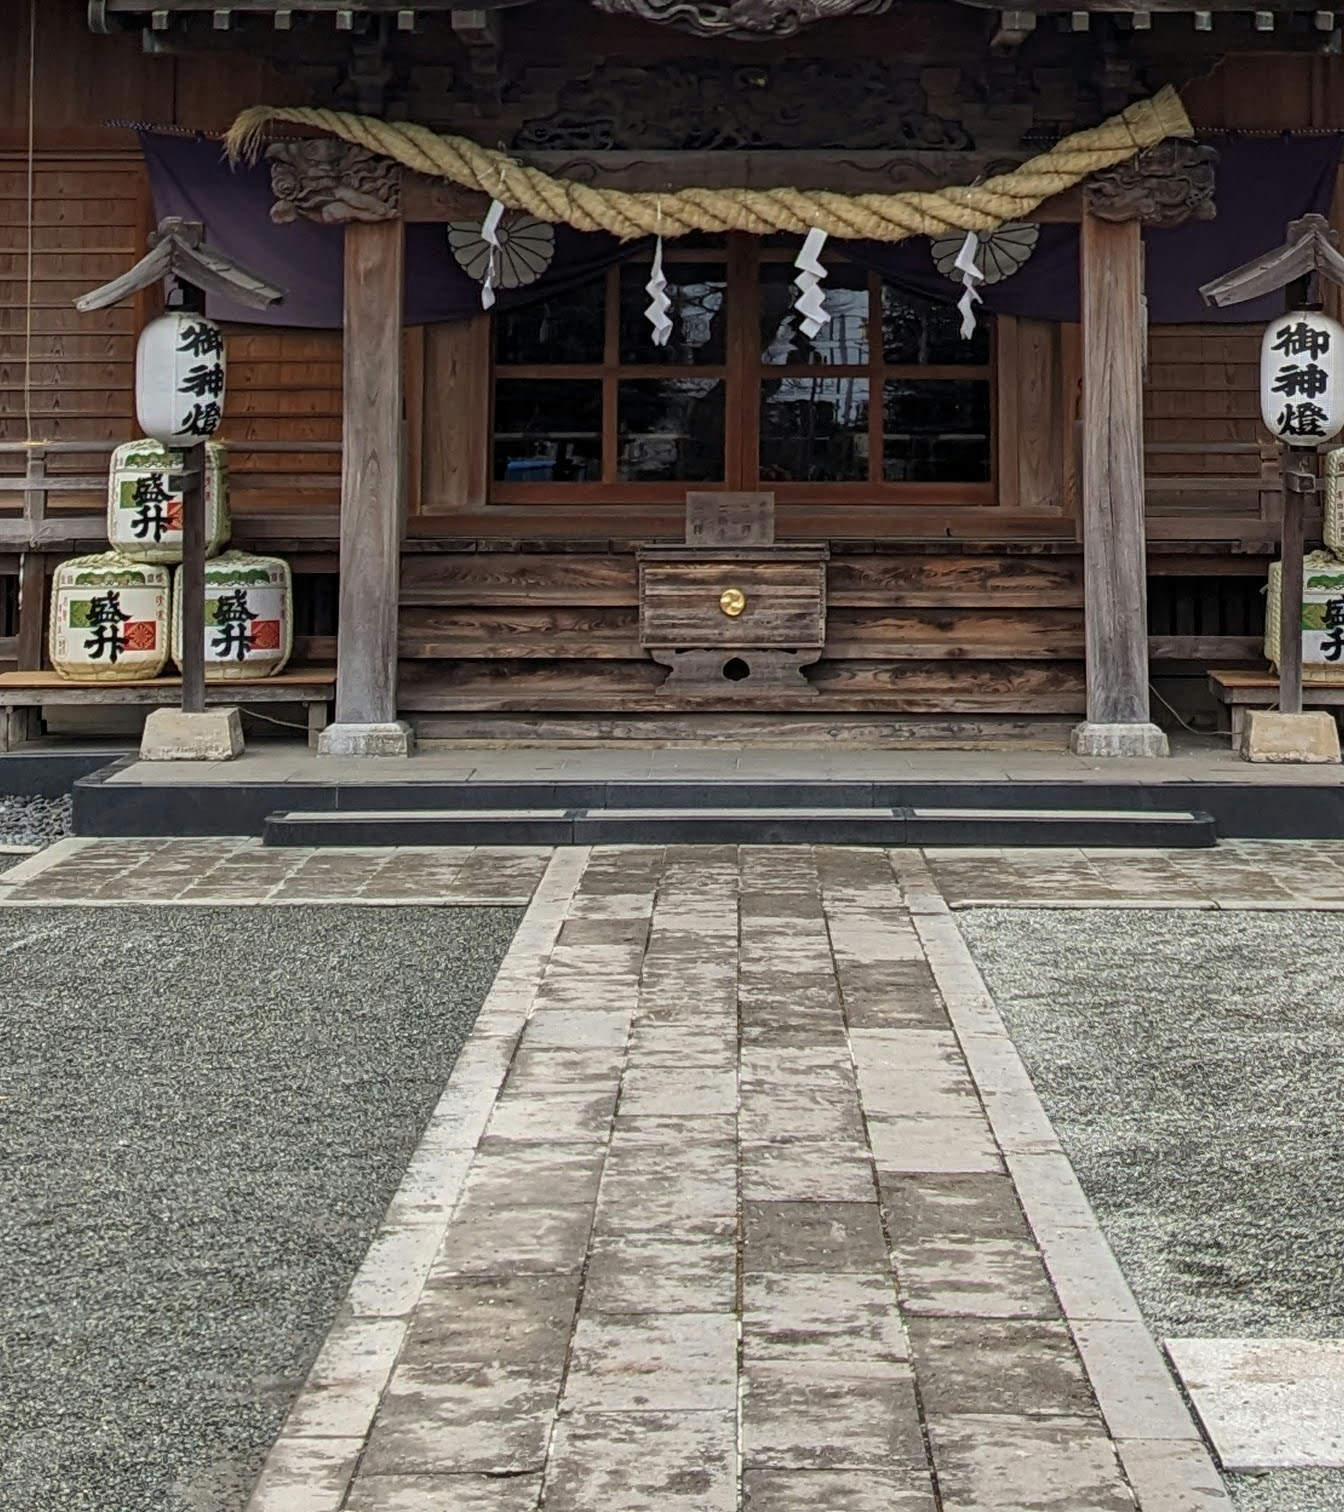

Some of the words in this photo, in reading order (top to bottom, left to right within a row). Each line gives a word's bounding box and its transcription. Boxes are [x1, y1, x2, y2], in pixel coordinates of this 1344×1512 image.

[172, 322, 224, 436] 御神燈
[1270, 321, 1331, 437] 御神燈
[131, 473, 177, 543] 盛升
[83, 589, 133, 664] 盛升
[210, 588, 260, 662] 盛升
